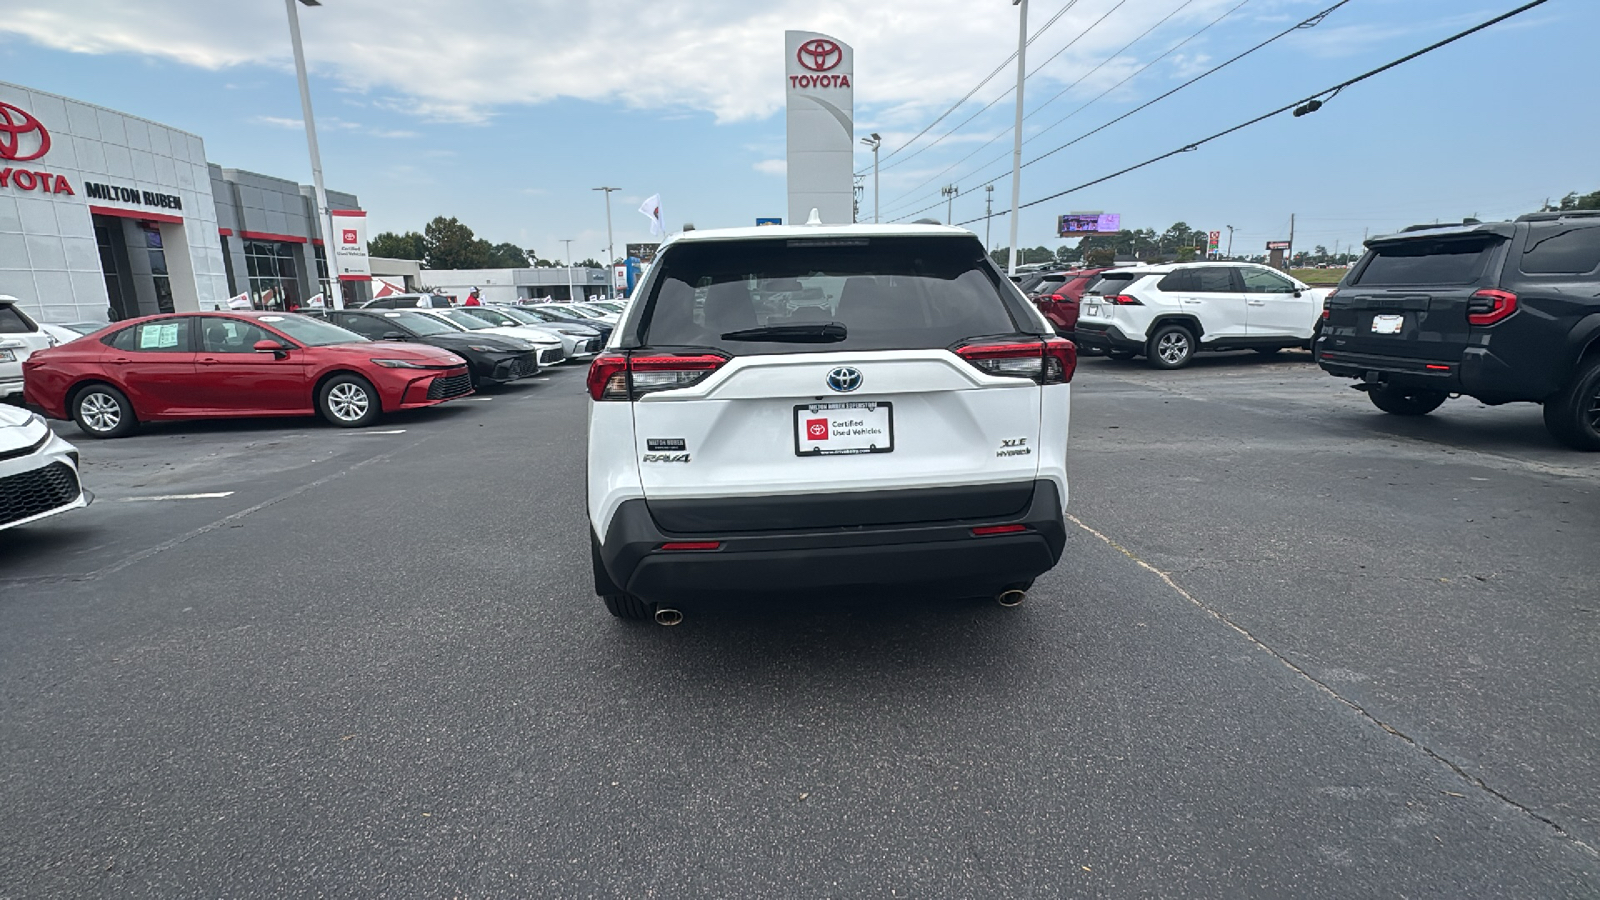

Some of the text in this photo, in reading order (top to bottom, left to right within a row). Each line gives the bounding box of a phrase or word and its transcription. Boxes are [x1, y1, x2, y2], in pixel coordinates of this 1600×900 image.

[789, 74, 851, 89] TOYOTA
[85, 181, 182, 210] MILTON RUBEN
[832, 420, 864, 428] Certified
[852, 427, 882, 436] Vehicles
[1000, 437, 1027, 448] XLE
[996, 447, 1031, 457] HYBRID
[642, 453, 692, 463] RAV4
